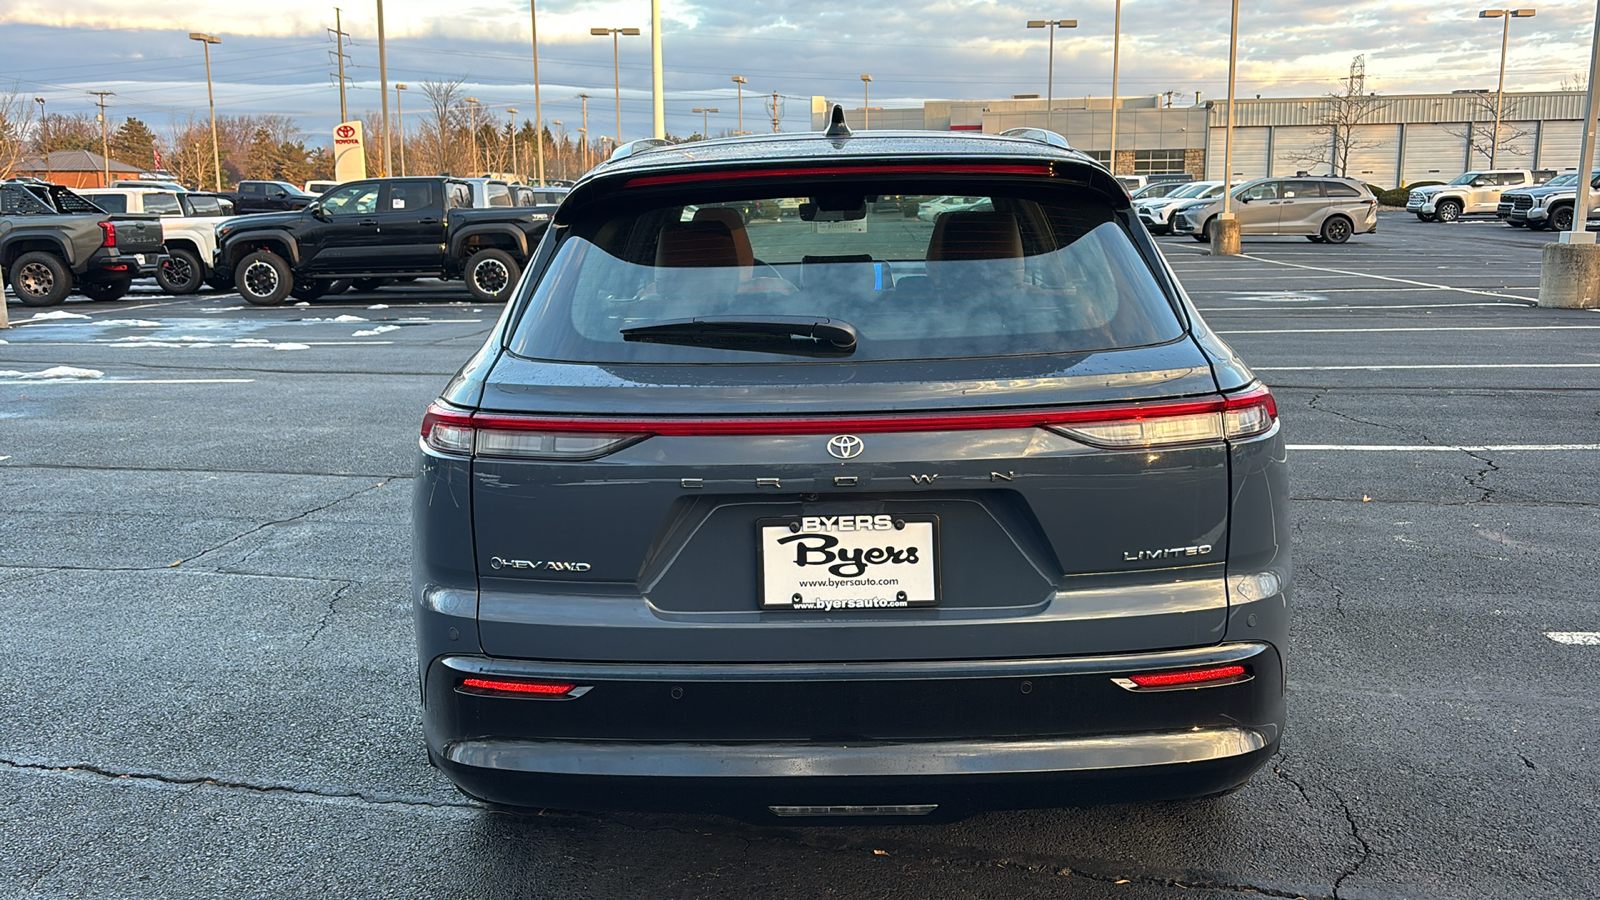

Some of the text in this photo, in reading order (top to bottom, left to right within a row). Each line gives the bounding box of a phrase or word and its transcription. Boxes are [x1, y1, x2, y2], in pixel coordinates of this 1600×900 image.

[680, 471, 1015, 489] CROWN
[802, 514, 893, 532] BYERS
[776, 533, 920, 578] Byers
[1123, 544, 1212, 560] LIMITED
[501, 559, 591, 571] HEV AWD
[799, 577, 899, 588] www.byersauto.com
[793, 597, 908, 611] www.byersauto.com
